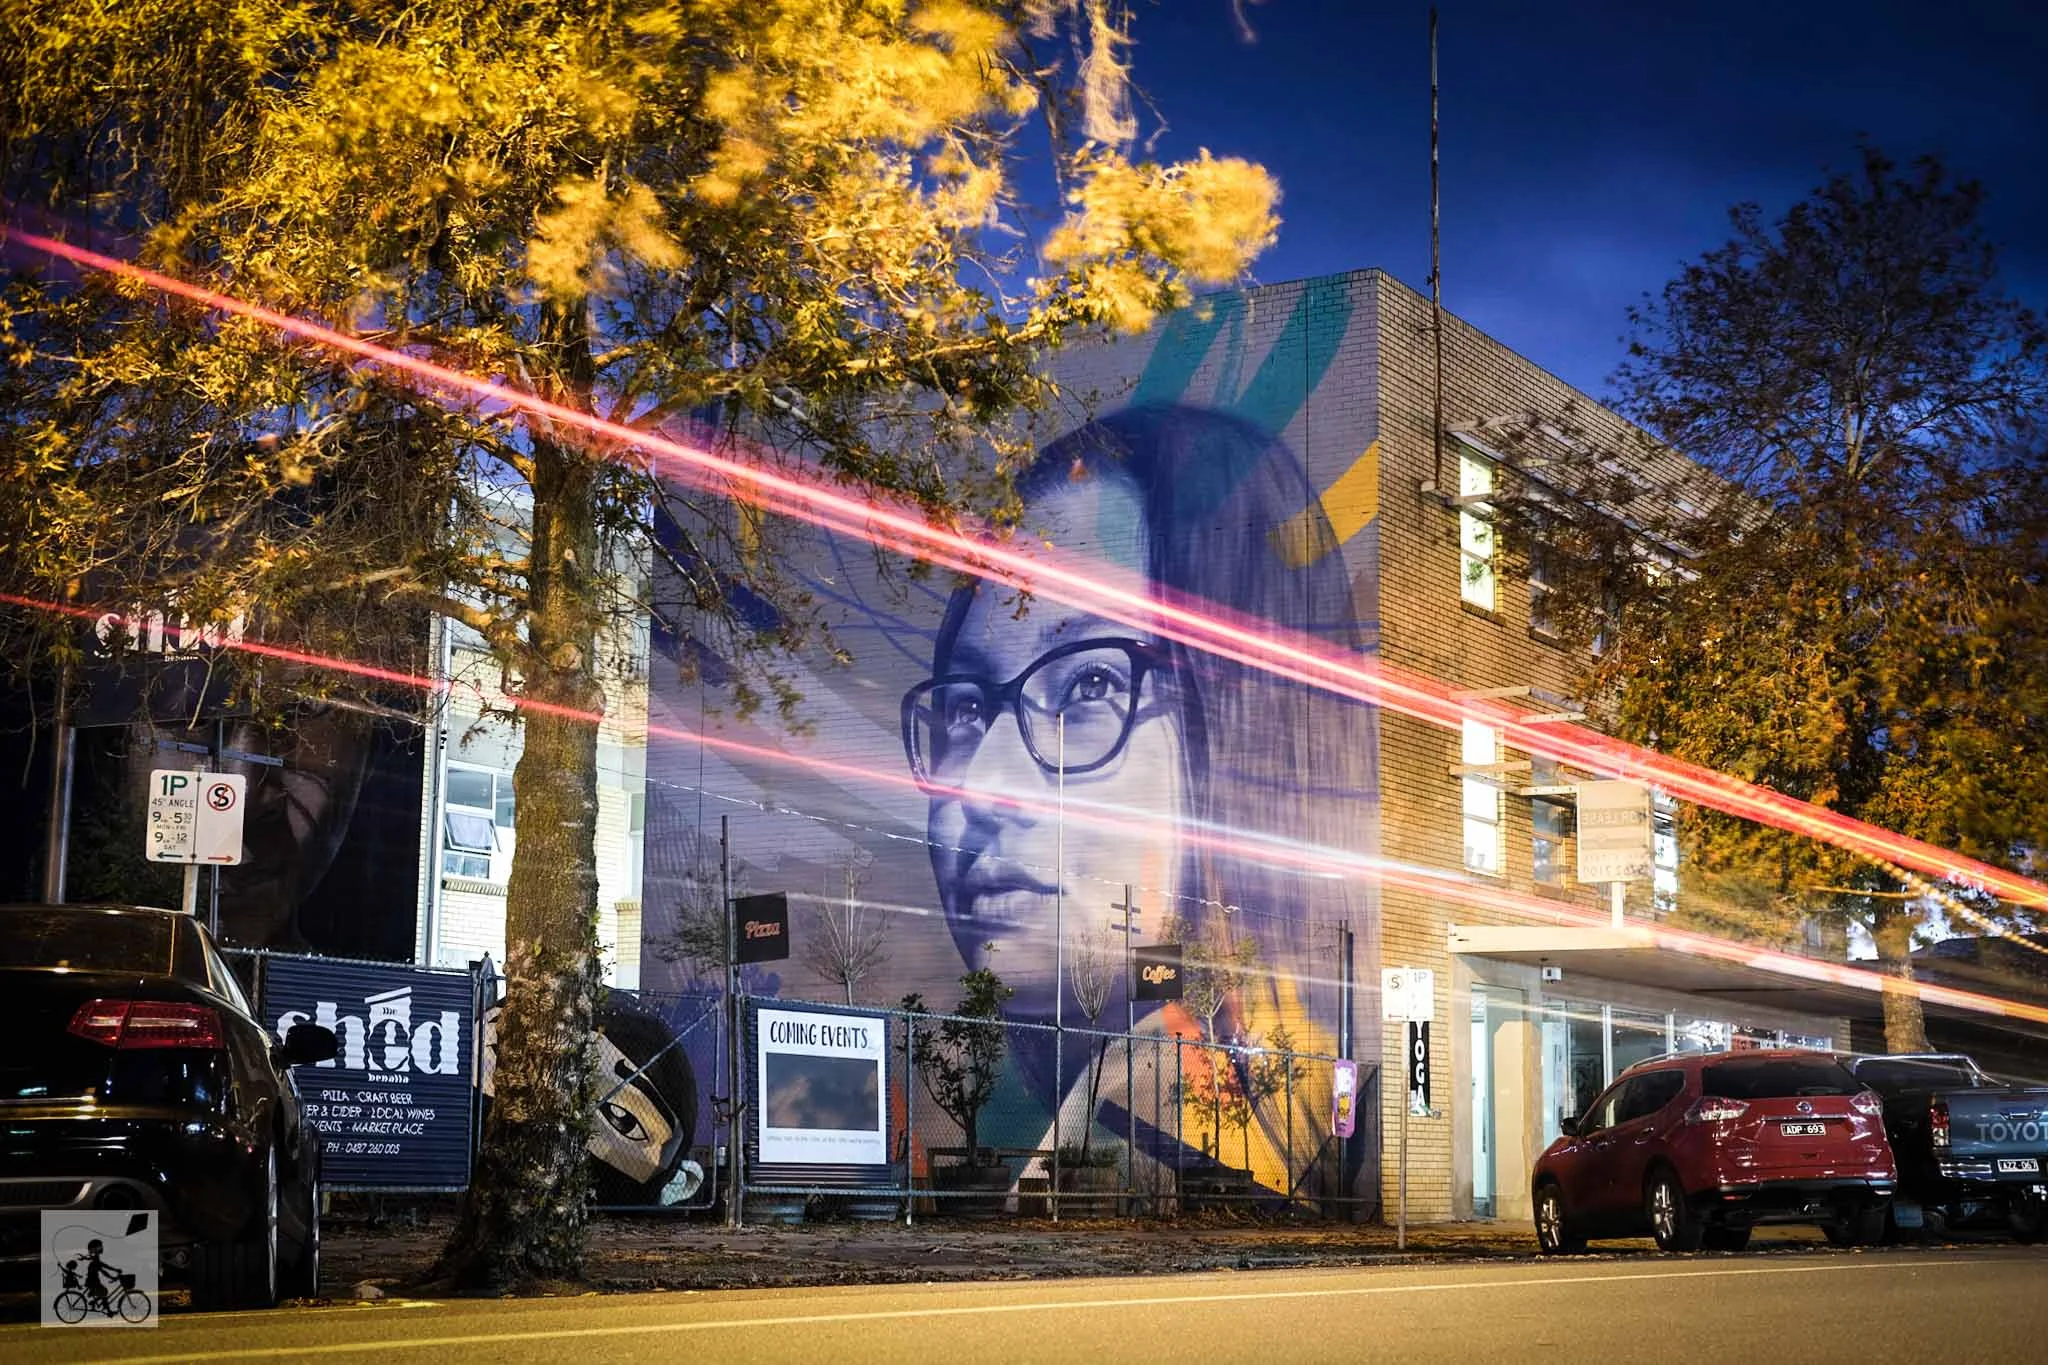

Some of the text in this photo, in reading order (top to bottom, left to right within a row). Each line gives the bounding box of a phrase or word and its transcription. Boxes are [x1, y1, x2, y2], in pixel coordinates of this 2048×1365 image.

[161, 775, 188, 796] 1P
[168, 799, 194, 809] ANGLE
[744, 920, 781, 940] Pizza
[1142, 965, 1177, 984] Coffee
[770, 1020, 869, 1049] COMING EVENTS
[1413, 1021, 1426, 1106] YOGA
[367, 1072, 409, 1084] benalla
[357, 1091, 388, 1103] CRAFT
[390, 1093, 413, 1105] BEER
[305, 1104, 320, 1117] ER
[331, 1106, 362, 1118] CIDER
[371, 1107, 404, 1120] LOCAL
[407, 1108, 436, 1121] WINES
[311, 1119, 424, 1135] VENTS MARKET PLACE
[345, 1142, 367, 1154] 0487
[384, 1143, 401, 1155] 005
